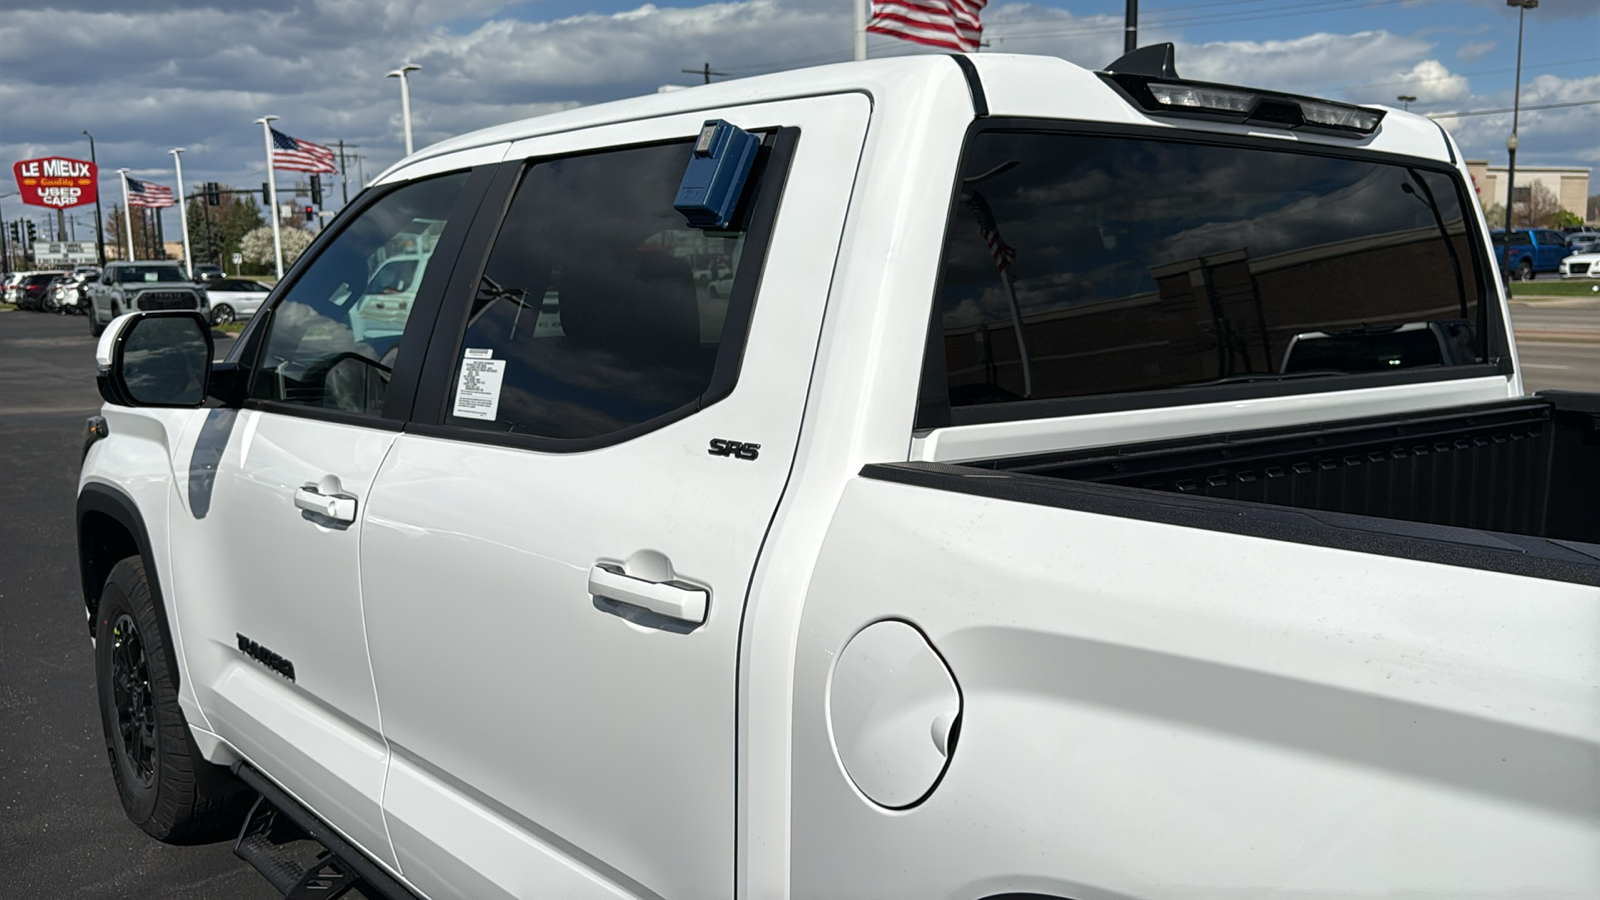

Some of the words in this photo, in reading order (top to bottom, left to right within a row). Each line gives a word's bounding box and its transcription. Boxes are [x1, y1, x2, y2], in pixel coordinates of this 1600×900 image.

[22, 162, 40, 177] LE
[43, 159, 91, 177] MIEUX
[37, 187, 82, 197] USED
[43, 196, 78, 207] CARS
[708, 438, 761, 461] SR5
